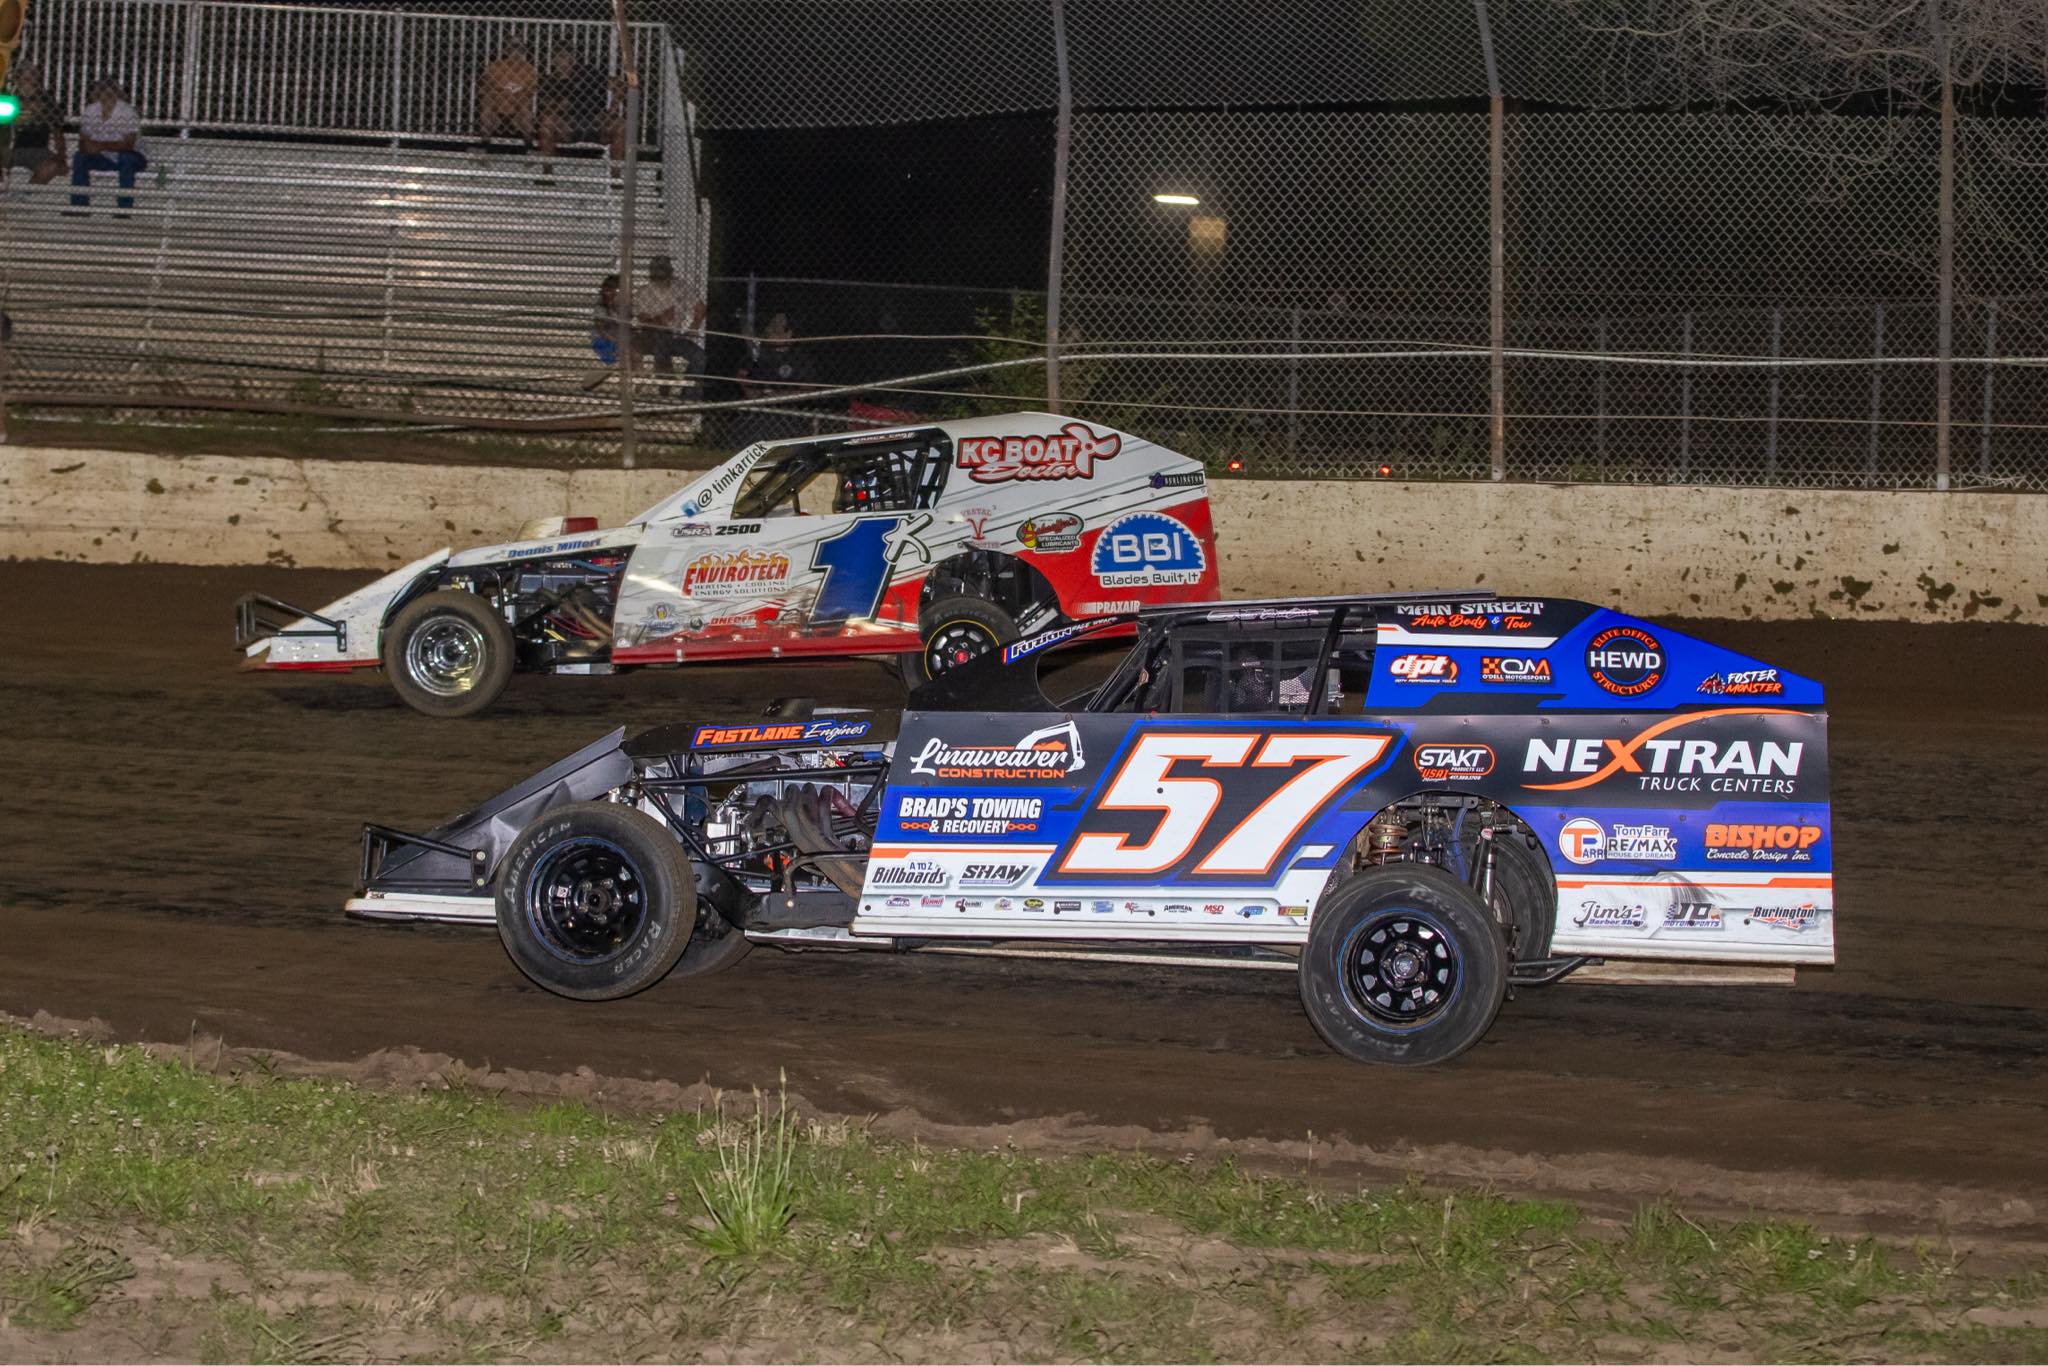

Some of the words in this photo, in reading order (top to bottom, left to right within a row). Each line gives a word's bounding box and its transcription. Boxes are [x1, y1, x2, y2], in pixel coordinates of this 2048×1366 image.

[961, 441, 998, 463] KC
[1002, 439, 1079, 461] BOAT
[971, 462, 1082, 481] Doctor
[715, 524, 761, 536] 2500
[1112, 532, 1182, 563] BBI
[682, 563, 789, 596] ENVIROTECH
[1102, 575, 1149, 586] Blades
[1153, 572, 1184, 584] Built
[1188, 572, 1198, 582] It
[1097, 601, 1140, 615] PRAXAIR
[1397, 604, 1451, 616] MAIN
[1460, 602, 1544, 616] STREET
[1412, 614, 1446, 627] Auto
[1449, 614, 1487, 629] Body
[1504, 615, 1532, 630] Tow
[1593, 629, 1621, 648] ELITE
[1622, 629, 1659, 650] OFFICE
[1391, 654, 1449, 679] dpt
[1590, 651, 1661, 669] HEWD
[1592, 671, 1660, 695] STRUCTURES
[1728, 669, 1777, 684] FOSTER
[1725, 683, 1782, 694] MONSTER
[695, 725, 804, 746] FASTLANE
[803, 722, 865, 742] Engines
[910, 738, 1067, 776] Linaweaver
[1418, 749, 1488, 767] STAKT
[1522, 738, 1804, 776] NEXTRAN
[938, 768, 1065, 779] CONSTRUCTION
[1640, 776, 1702, 792] TRUCK
[1710, 776, 1796, 793] CENTERS
[899, 798, 971, 819] BRAD'S
[973, 799, 1042, 819] TOWING
[1057, 733, 1393, 874] 57
[929, 820, 940, 833] &
[943, 820, 1010, 834] RECOVERY
[1616, 826, 1643, 838] Tony
[1645, 826, 1668, 836] Farr
[1705, 824, 1821, 849] BISHOP
[1609, 839, 1674, 852] RE/MAX
[1706, 848, 1749, 860] Concrete
[1752, 849, 1788, 862] Design
[909, 862, 915, 870] A
[917, 862, 926, 870] TO
[927, 862, 933, 870] Z
[961, 865, 1029, 882] SHAW
[872, 867, 946, 884] Billboards
[1573, 901, 1633, 926] Jim's
[1753, 907, 1815, 919] Burlington
[1662, 920, 1721, 928] MOTORPORTS
